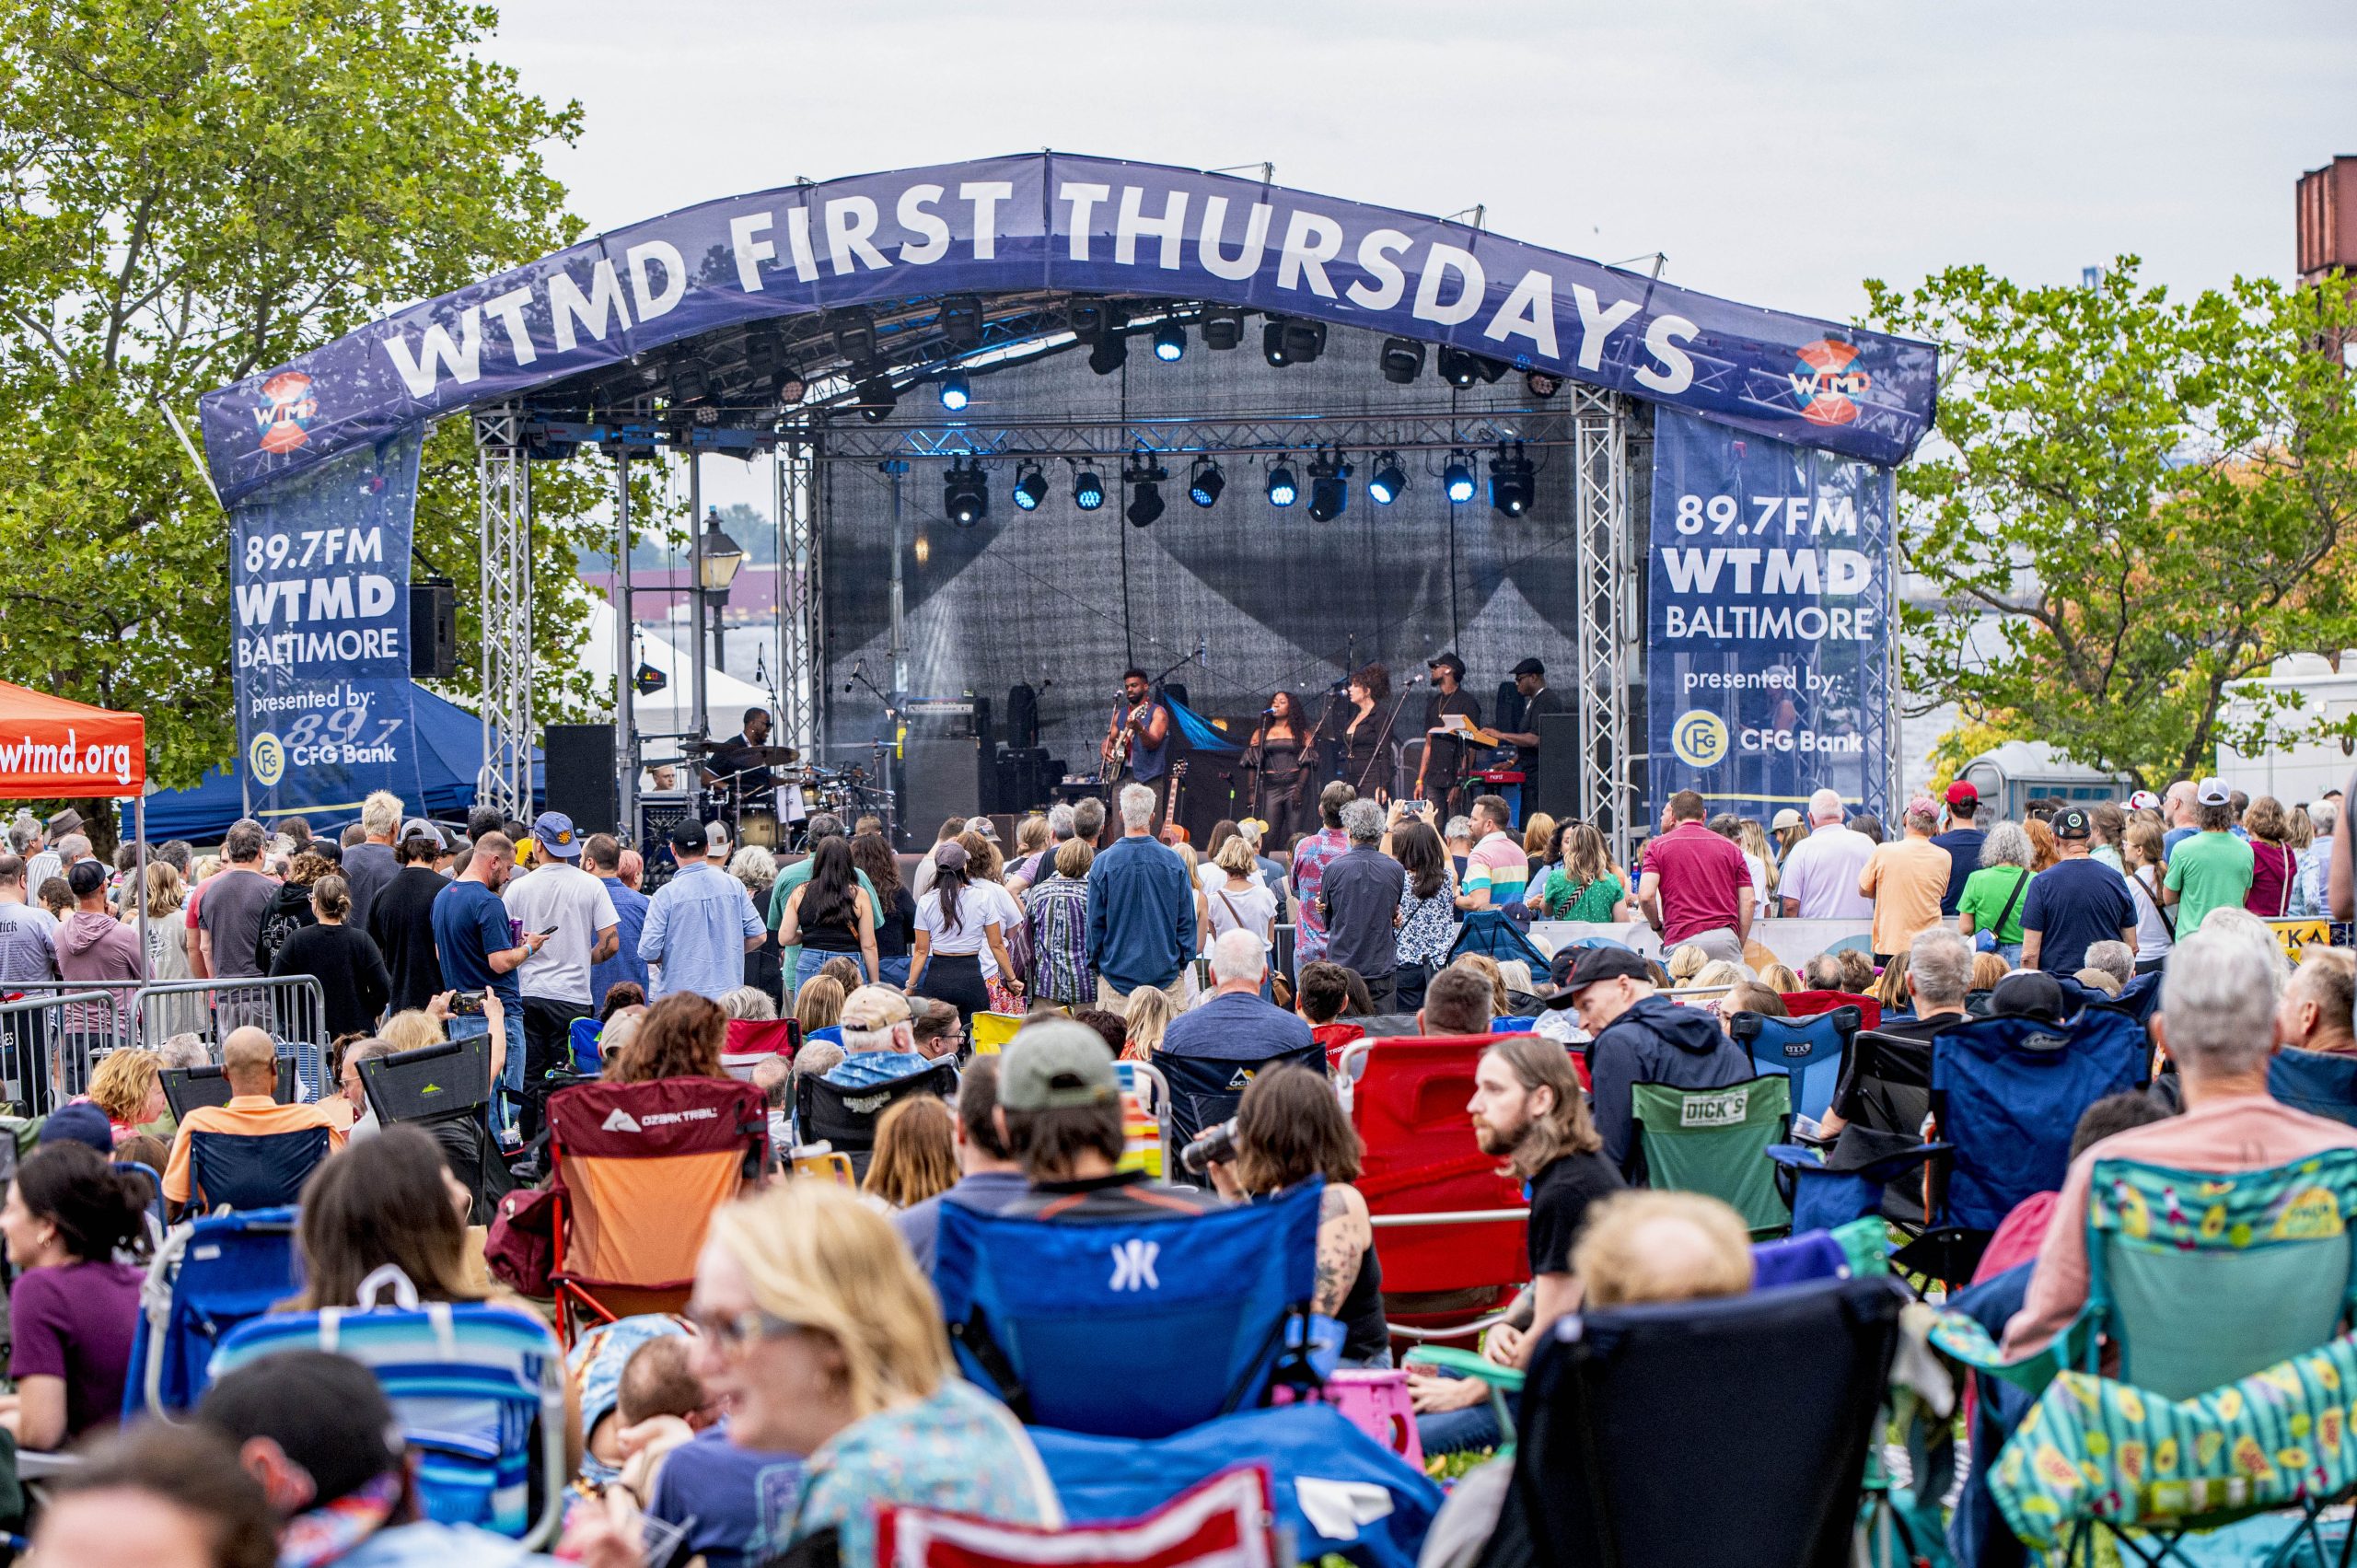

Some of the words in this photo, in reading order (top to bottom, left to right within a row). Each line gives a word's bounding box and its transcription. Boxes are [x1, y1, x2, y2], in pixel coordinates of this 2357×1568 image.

[383, 240, 689, 400] WTMD
[730, 181, 1014, 292] FIRST
[1059, 180, 1702, 394] THURSDAYS
[1676, 494, 1858, 537] 89.7FM
[245, 527, 383, 574] 89.7FM
[1661, 547, 1873, 596] WTMD
[235, 575, 396, 627] WTMD
[1666, 605, 1875, 641] BALTIMORE
[238, 628, 399, 668] BALTIMORE
[1684, 667, 1795, 694] presented
[1806, 665, 1842, 697] by:
[252, 684, 340, 718] presented
[346, 684, 376, 712] by:
[0, 728, 132, 785] wtmd.org
[293, 744, 339, 767] CFG
[343, 743, 397, 764] Bank
[1740, 728, 1794, 752] CFG
[1800, 730, 1864, 753] Bank
[2276, 927, 2325, 948] KA
[642, 1111, 682, 1126] OZARK
